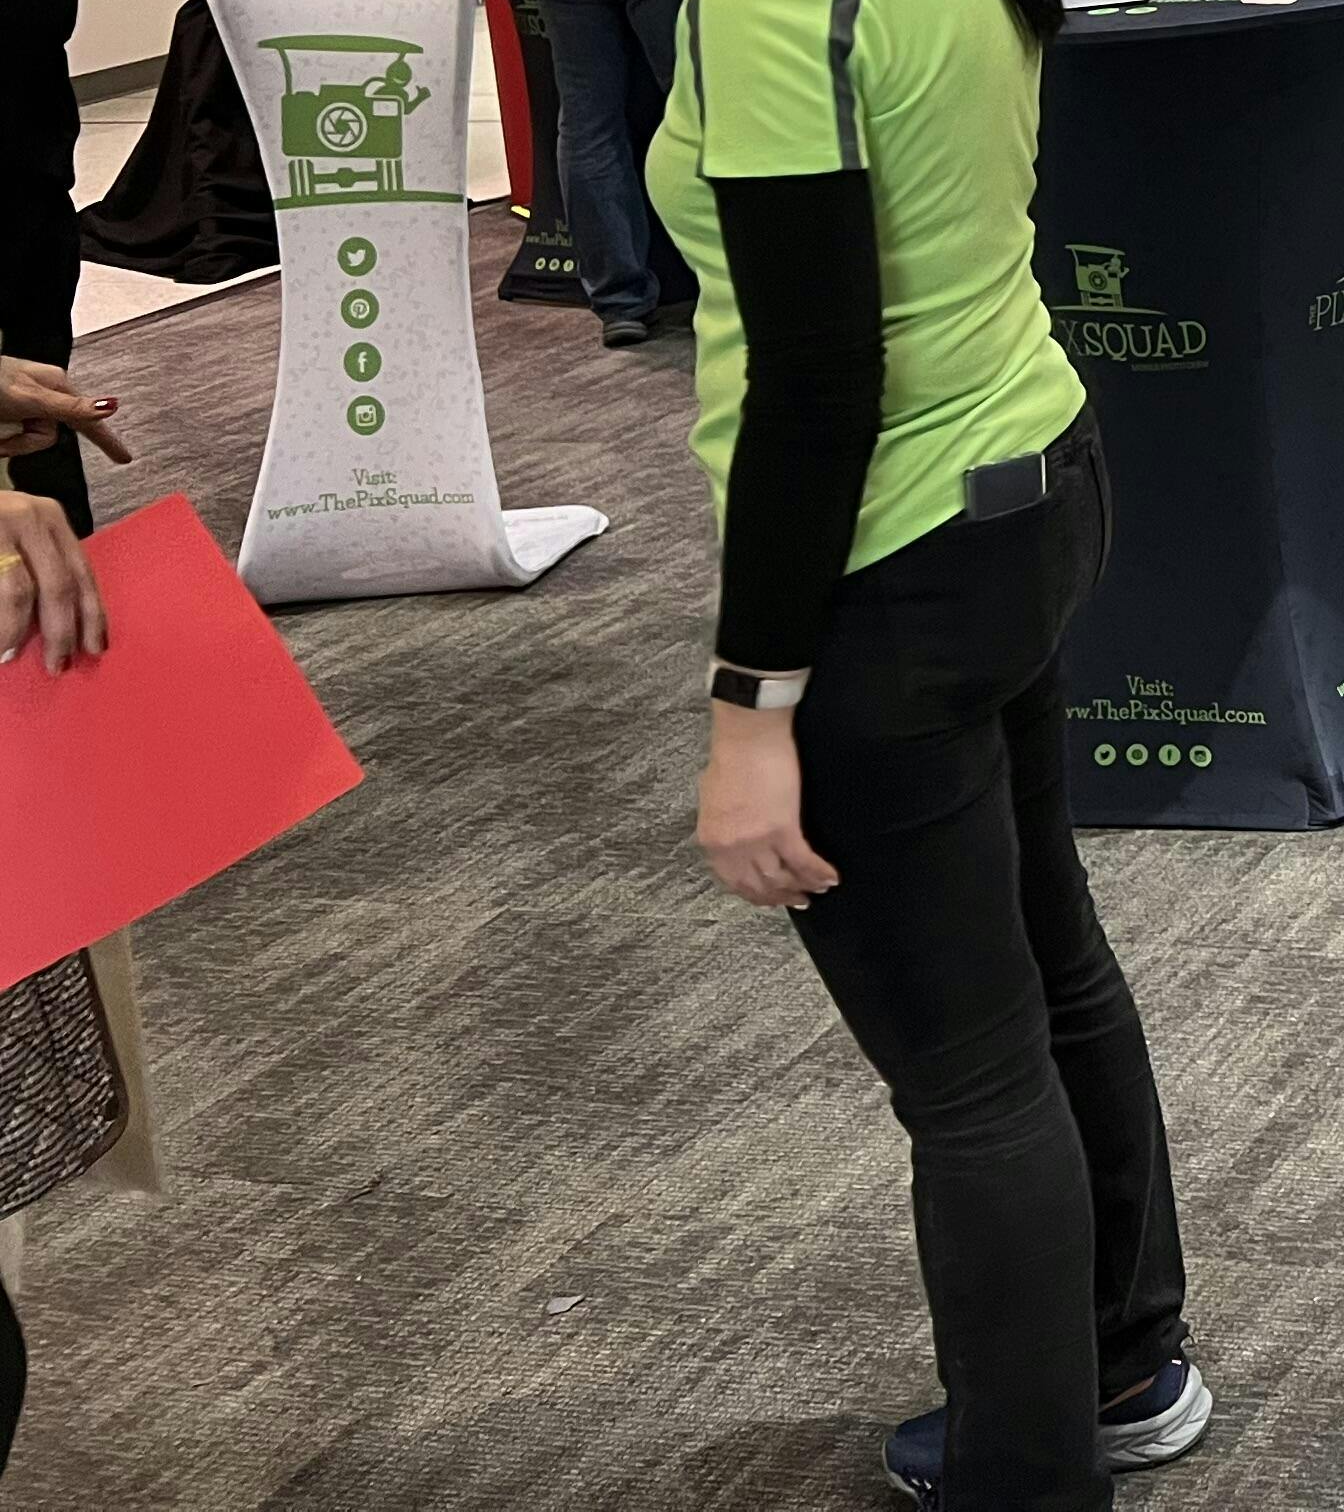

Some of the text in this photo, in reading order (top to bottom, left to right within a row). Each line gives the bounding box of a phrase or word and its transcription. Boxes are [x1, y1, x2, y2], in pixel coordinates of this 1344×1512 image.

[1058, 319, 1209, 362] XSQUAD
[351, 467, 397, 486] Visit:
[267, 488, 475, 521] www.ThePixSquad.com
[1126, 674, 1175, 697] Visit:
